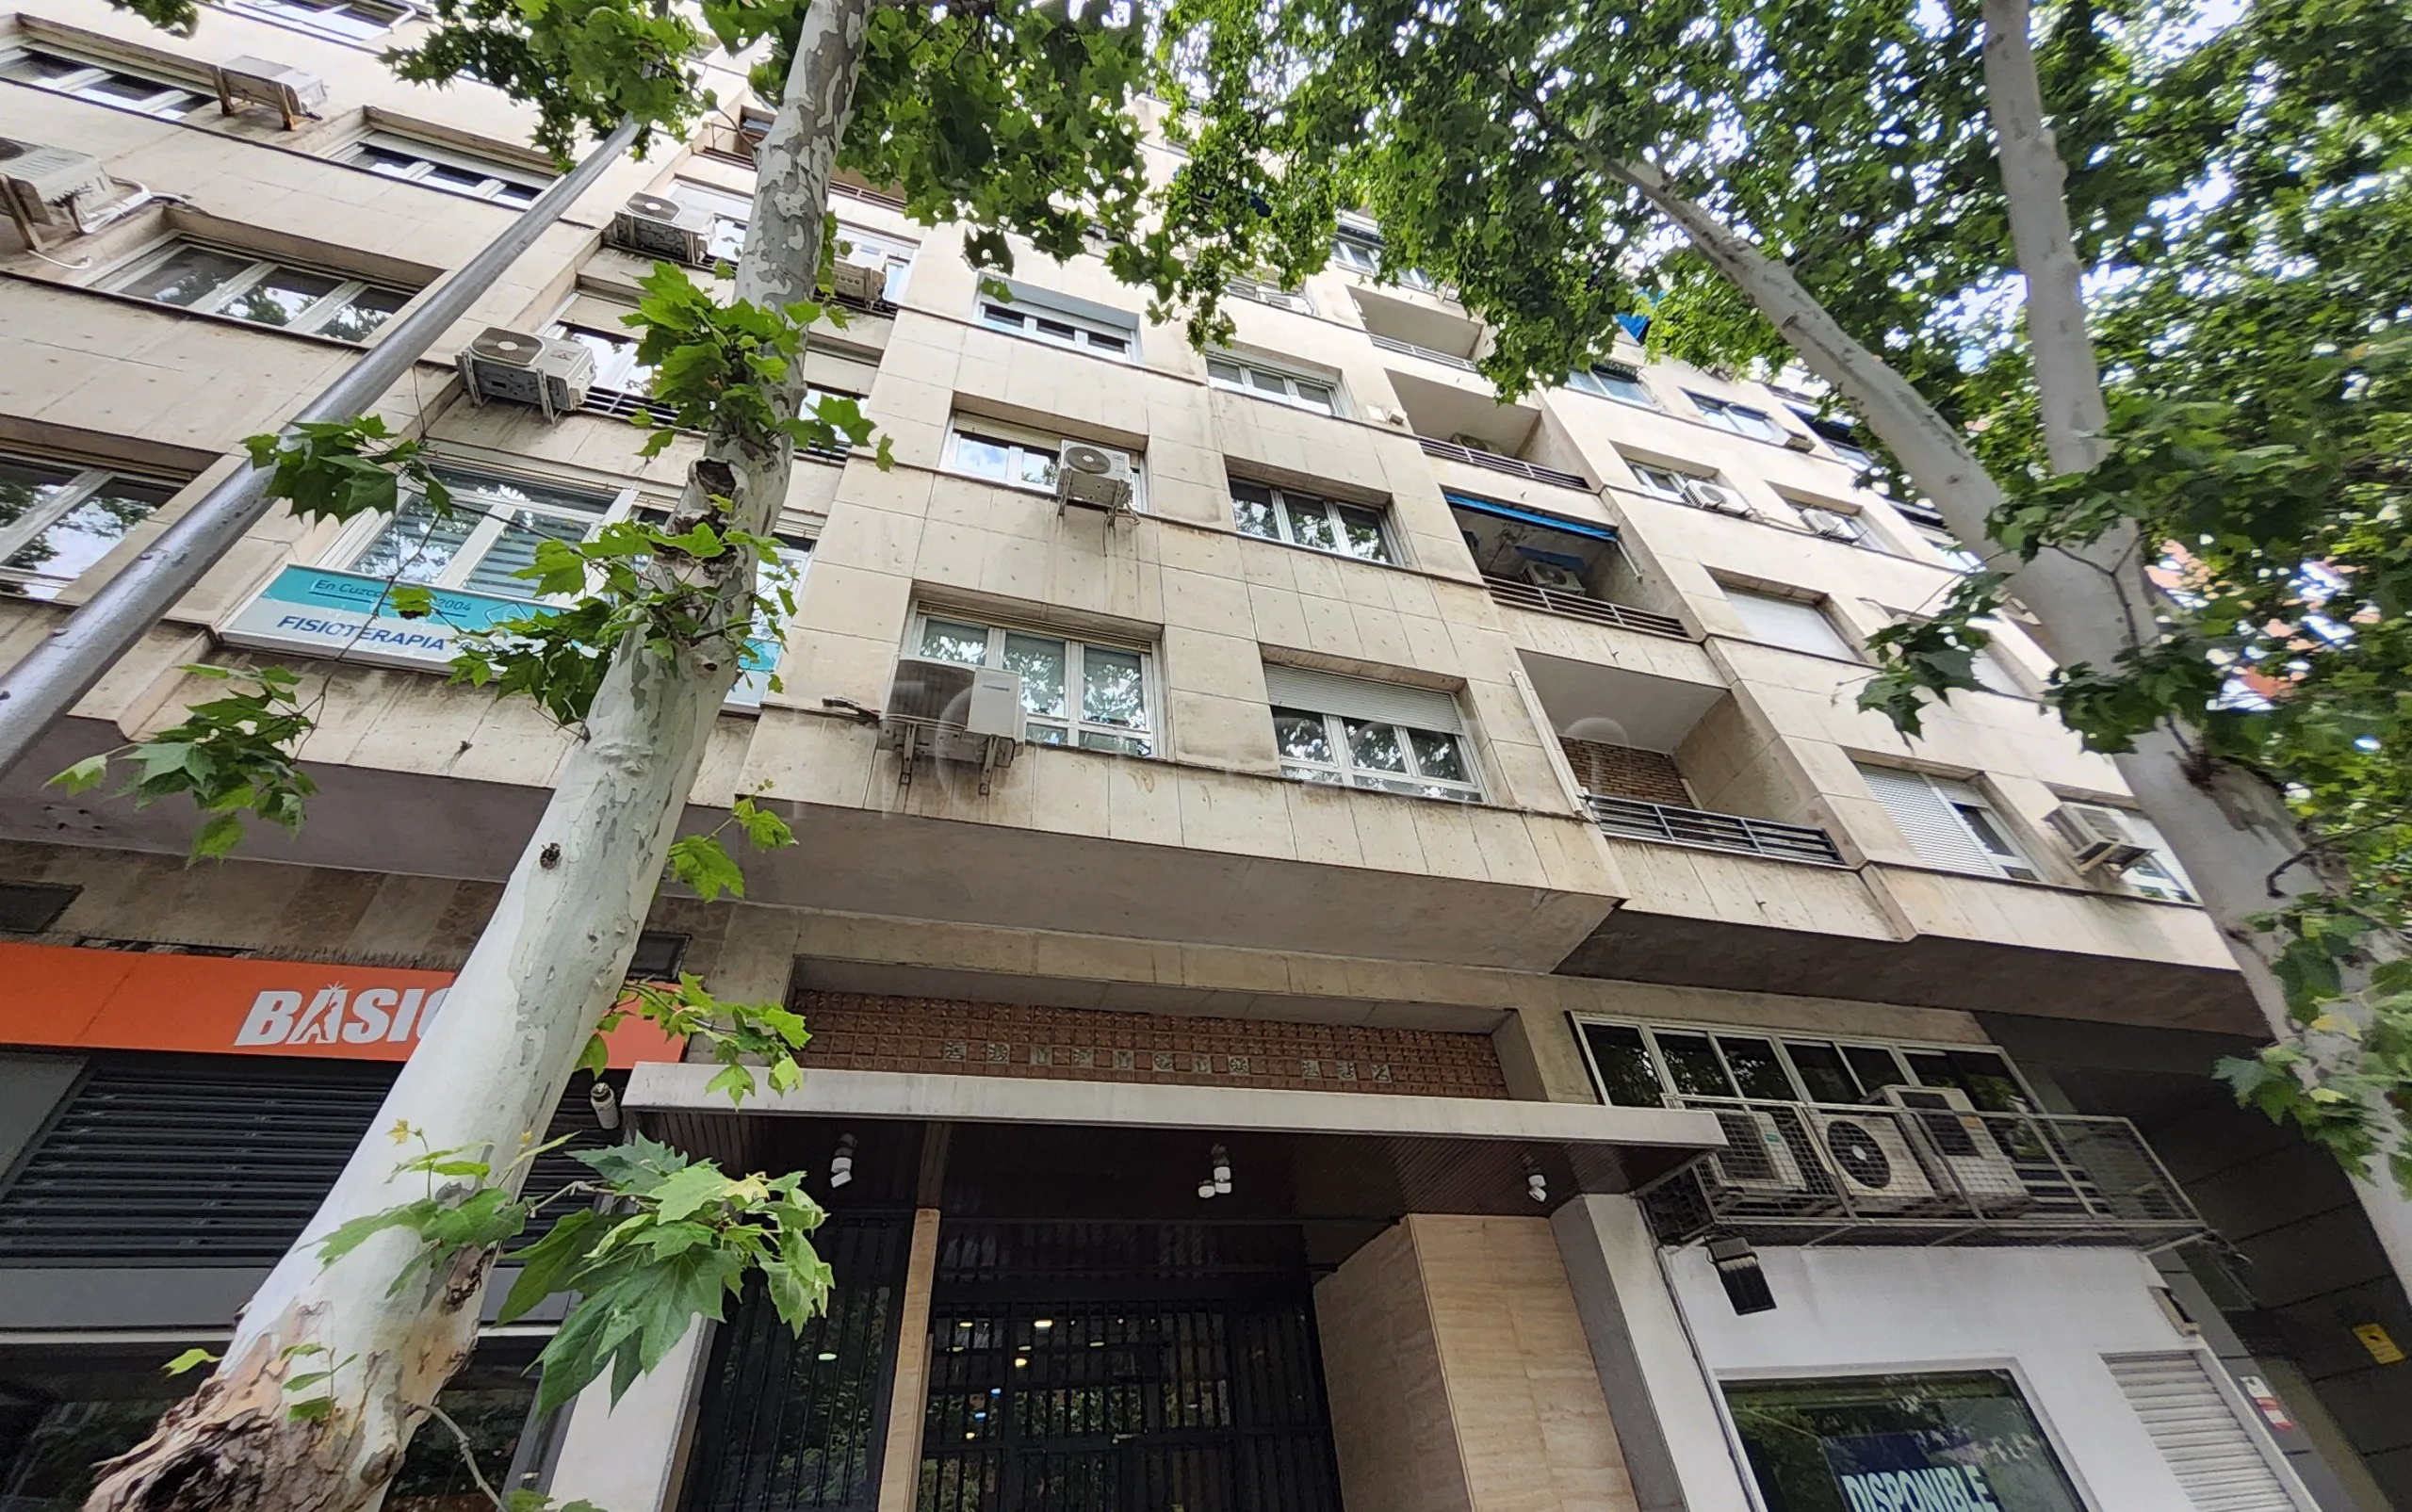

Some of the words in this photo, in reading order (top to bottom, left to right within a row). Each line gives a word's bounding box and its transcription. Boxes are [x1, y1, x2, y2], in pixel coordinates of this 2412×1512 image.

[315, 578, 336, 592] En
[339, 583, 384, 599] Cuzco
[277, 615, 446, 651] FISIOTERAPIA
[1841, 1465, 2001, 1512] DISPONIBLE
